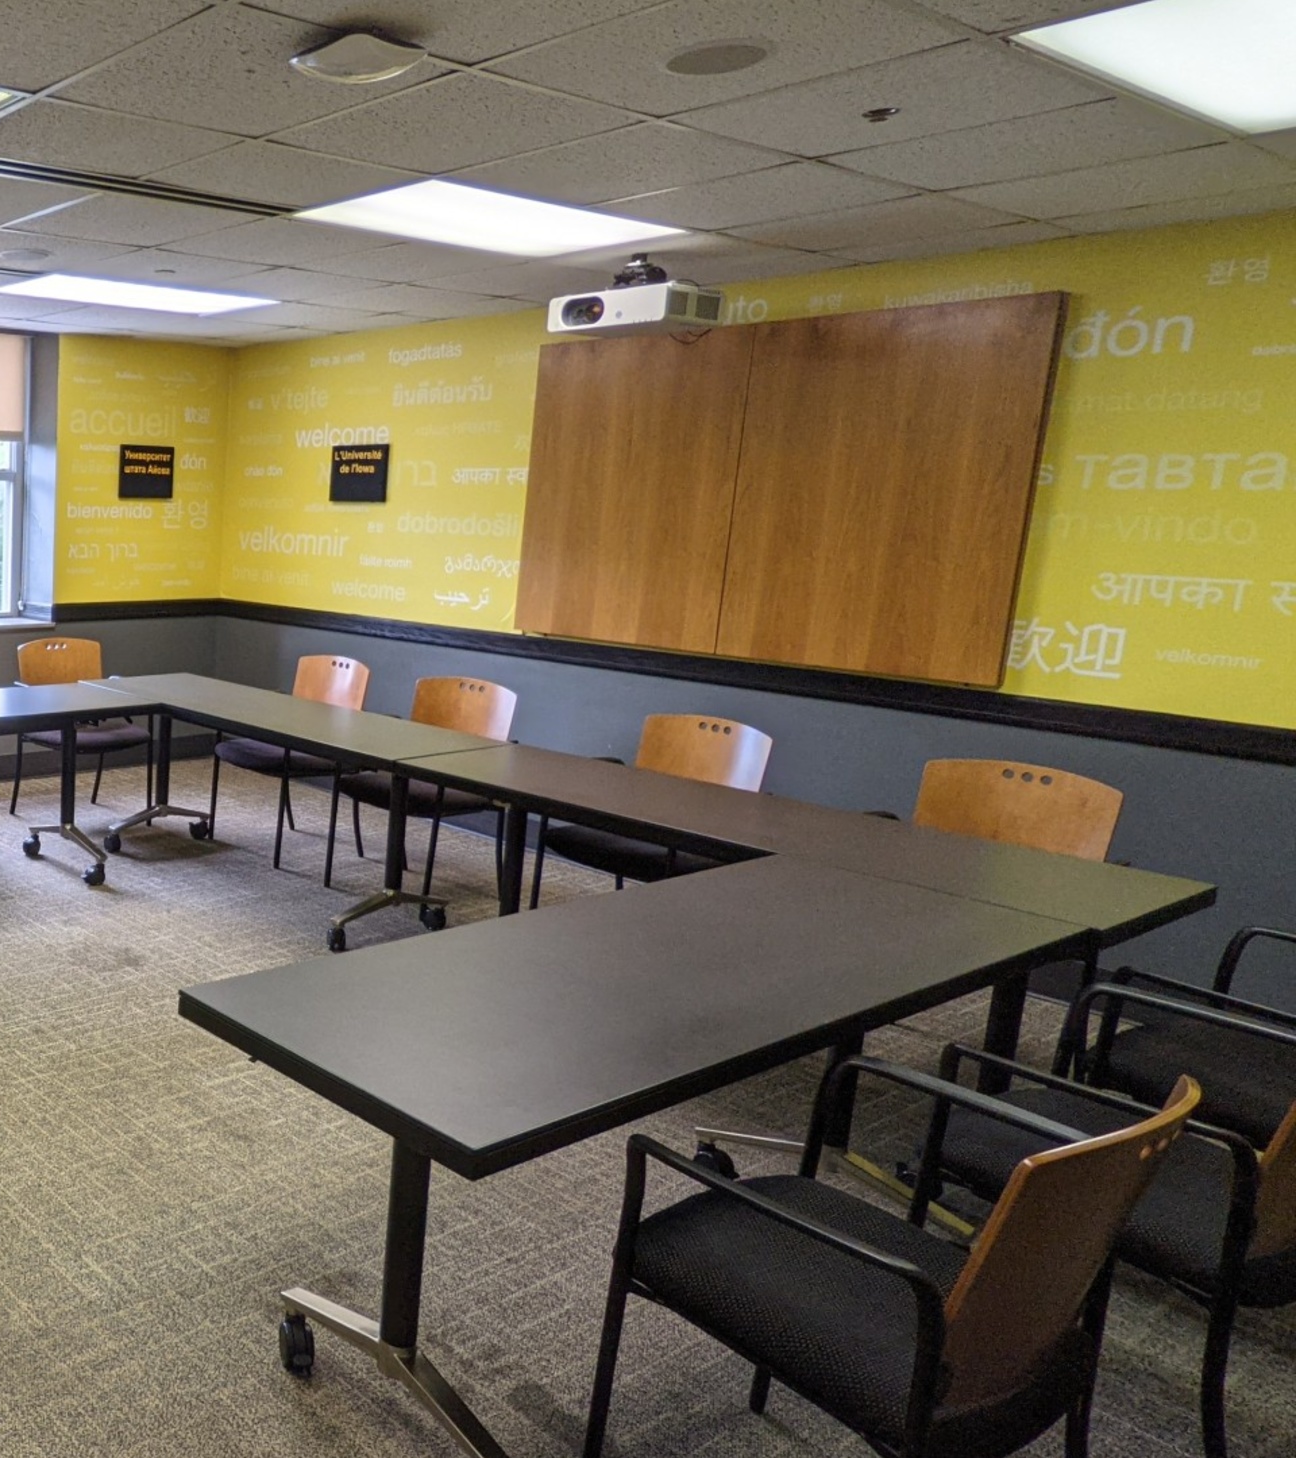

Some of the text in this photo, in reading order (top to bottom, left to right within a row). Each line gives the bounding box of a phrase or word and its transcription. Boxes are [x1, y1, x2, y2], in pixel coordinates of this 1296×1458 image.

[69, 404, 176, 438] accueil
[295, 421, 390, 449] welcome
[124, 450, 171, 463] Университет
[334, 450, 382, 461] L'Université
[124, 466, 146, 474] штата
[148, 464, 171, 475] Айова
[339, 464, 349, 473] de
[1075, 452, 1296, 492] тавта
[67, 501, 153, 519] bienvenido
[397, 511, 519, 538] dobrodošli
[238, 525, 350, 557] velkomnir
[331, 578, 407, 602] welcome
[1091, 571, 1253, 613] आपका
[1156, 649, 1264, 670] velkomnir
